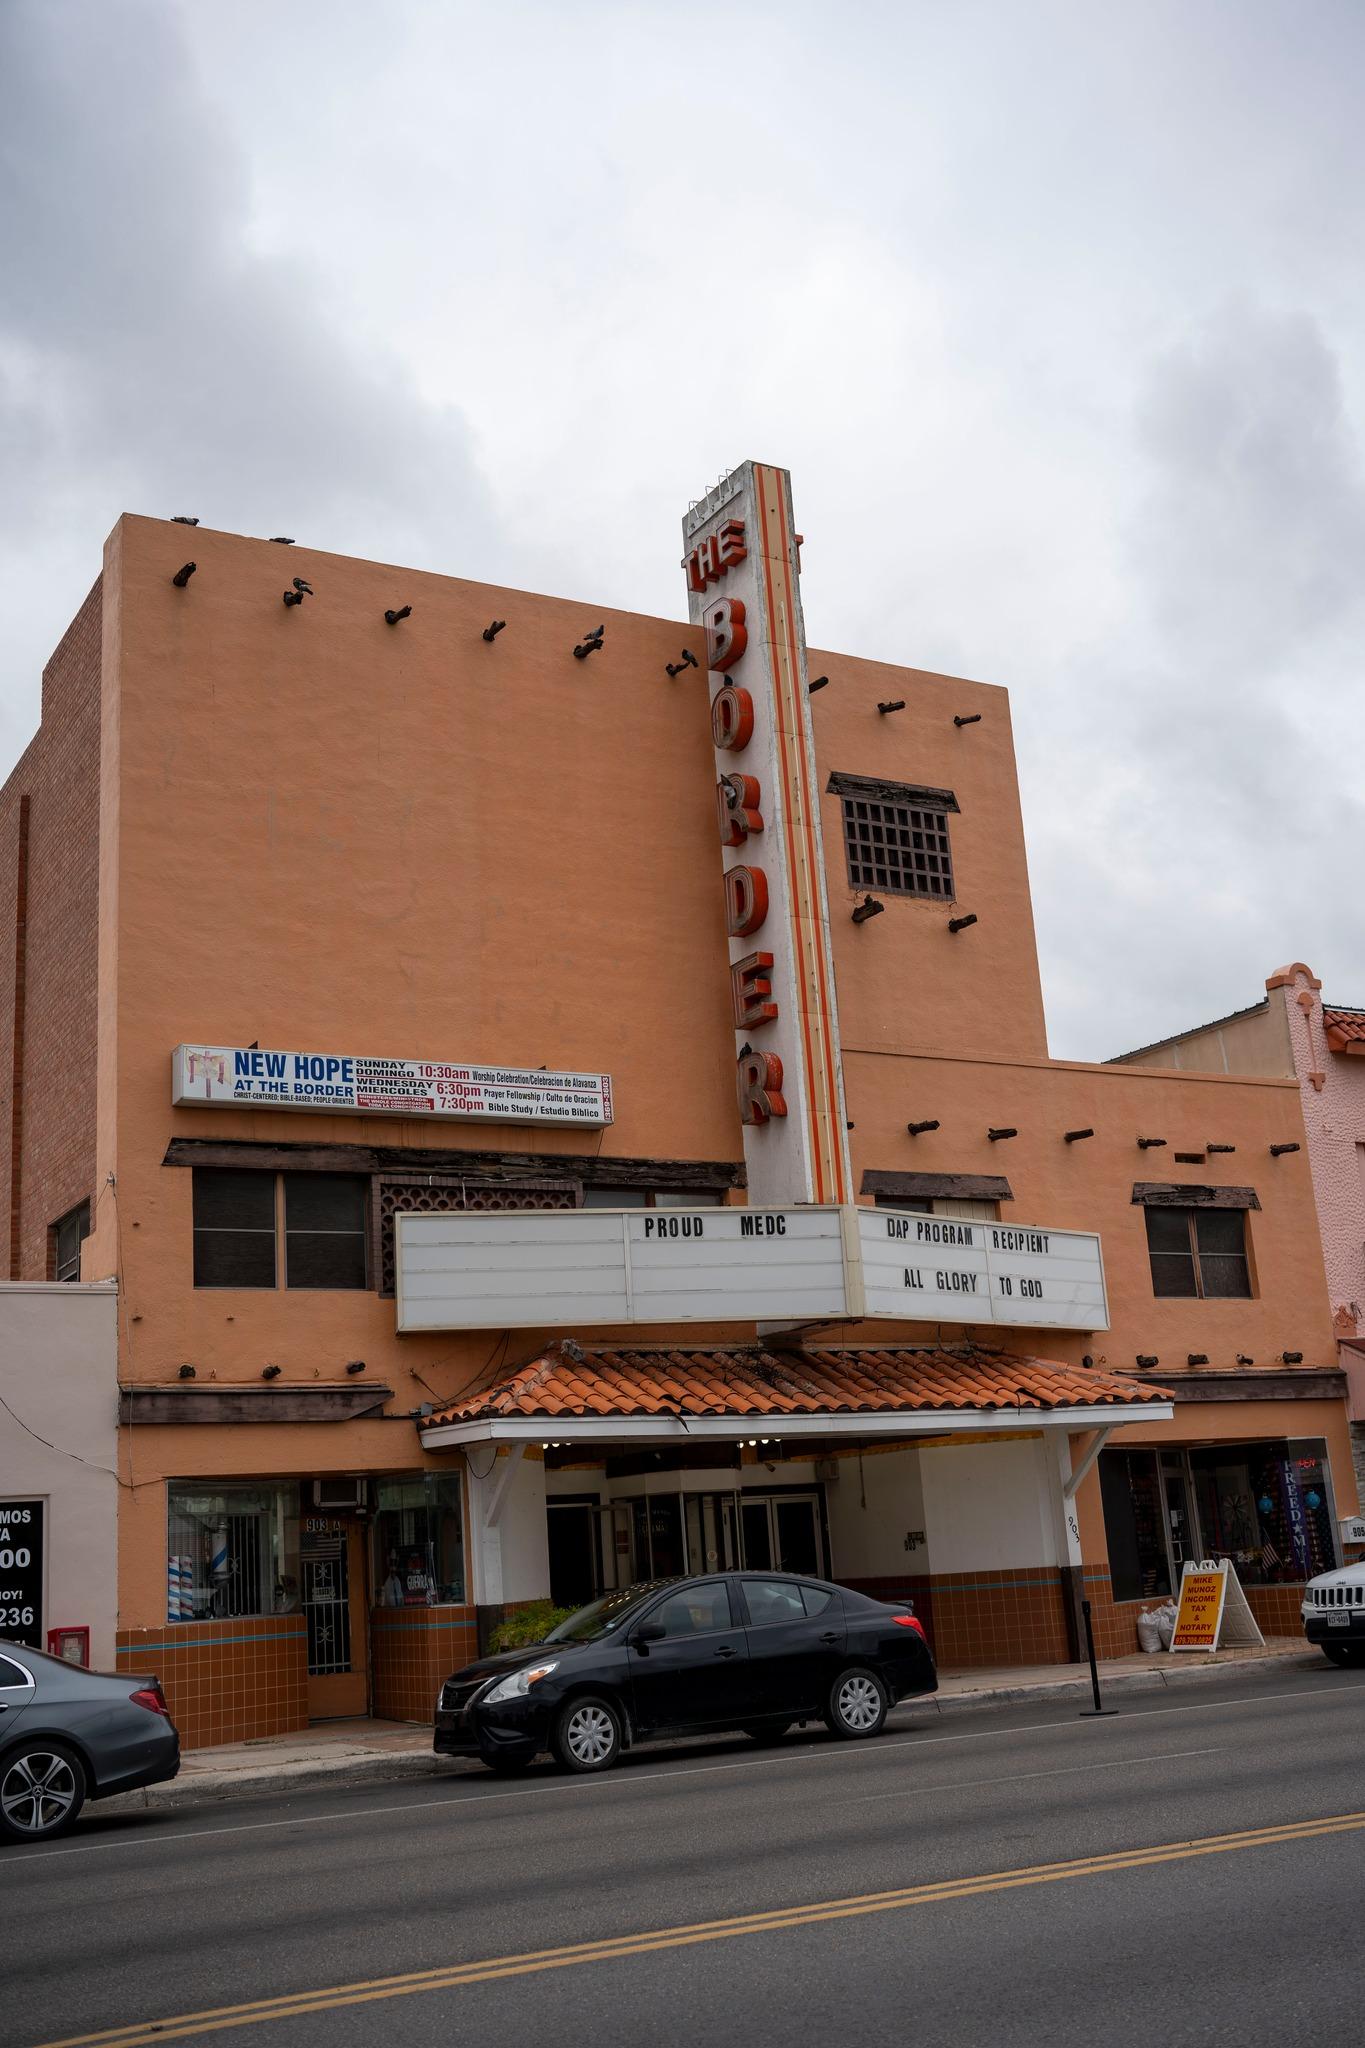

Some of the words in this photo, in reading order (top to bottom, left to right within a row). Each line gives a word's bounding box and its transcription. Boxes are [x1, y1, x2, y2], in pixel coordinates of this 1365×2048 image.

[681, 519, 747, 593] THE
[702, 597, 787, 1125] BORDER
[234, 1051, 286, 1078] NEW
[295, 1056, 354, 1083] HOPE
[355, 1060, 406, 1070] SUNDAY
[356, 1068, 415, 1078] DOMINGO
[356, 1078, 434, 1089] WEDNESDAY
[418, 1065, 470, 1081] 10:30am
[472, 1070, 495, 1083] Worship
[496, 1072, 563, 1087] Celebration/Celebracion
[564, 1078, 572, 1088] de
[572, 1078, 597, 1089] Alavanza
[234, 1079, 256, 1091] AT
[258, 1081, 289, 1093] THE
[294, 1083, 354, 1097] BORDER
[356, 1086, 428, 1096] MIERCOLES
[436, 1083, 481, 1098] 6:30pm
[484, 1088, 505, 1100] Prayer
[506, 1090, 541, 1102] Fellowship
[546, 1092, 564, 1103] Culto
[564, 1094, 573, 1104] de
[573, 1094, 598, 1105] Oracion
[439, 1097, 484, 1112] 7:30pm
[488, 1102, 510, 1113] Bible
[511, 1103, 534, 1115] Study
[540, 1105, 570, 1116] Estudio
[571, 1106, 599, 1118] Biblico
[644, 1216, 704, 1238] PROUD
[740, 1214, 786, 1236] MEDC
[886, 1217, 909, 1239] DAP
[917, 1221, 973, 1246] PROGRAM
[993, 1230, 1049, 1253] RECIPIENT
[904, 1268, 924, 1289] ALL
[936, 1271, 977, 1292] GLORY
[1000, 1276, 1012, 1296] TO
[1020, 1279, 1043, 1298] GOD
[0, 1510, 31, 1524] MOS
[307, 1518, 327, 1531] 903
[0, 1528, 11, 1541] A
[1068, 1516, 1080, 1543] 903
[0, 1548, 31, 1569] 00
[1193, 1576, 1213, 1584] MIKE
[1185, 1595, 1216, 1603] INCOME
[1187, 1586, 1217, 1594] MUNOZ
[0, 1607, 34, 1627] 236
[1180, 1623, 1212, 1631] NOTARY
